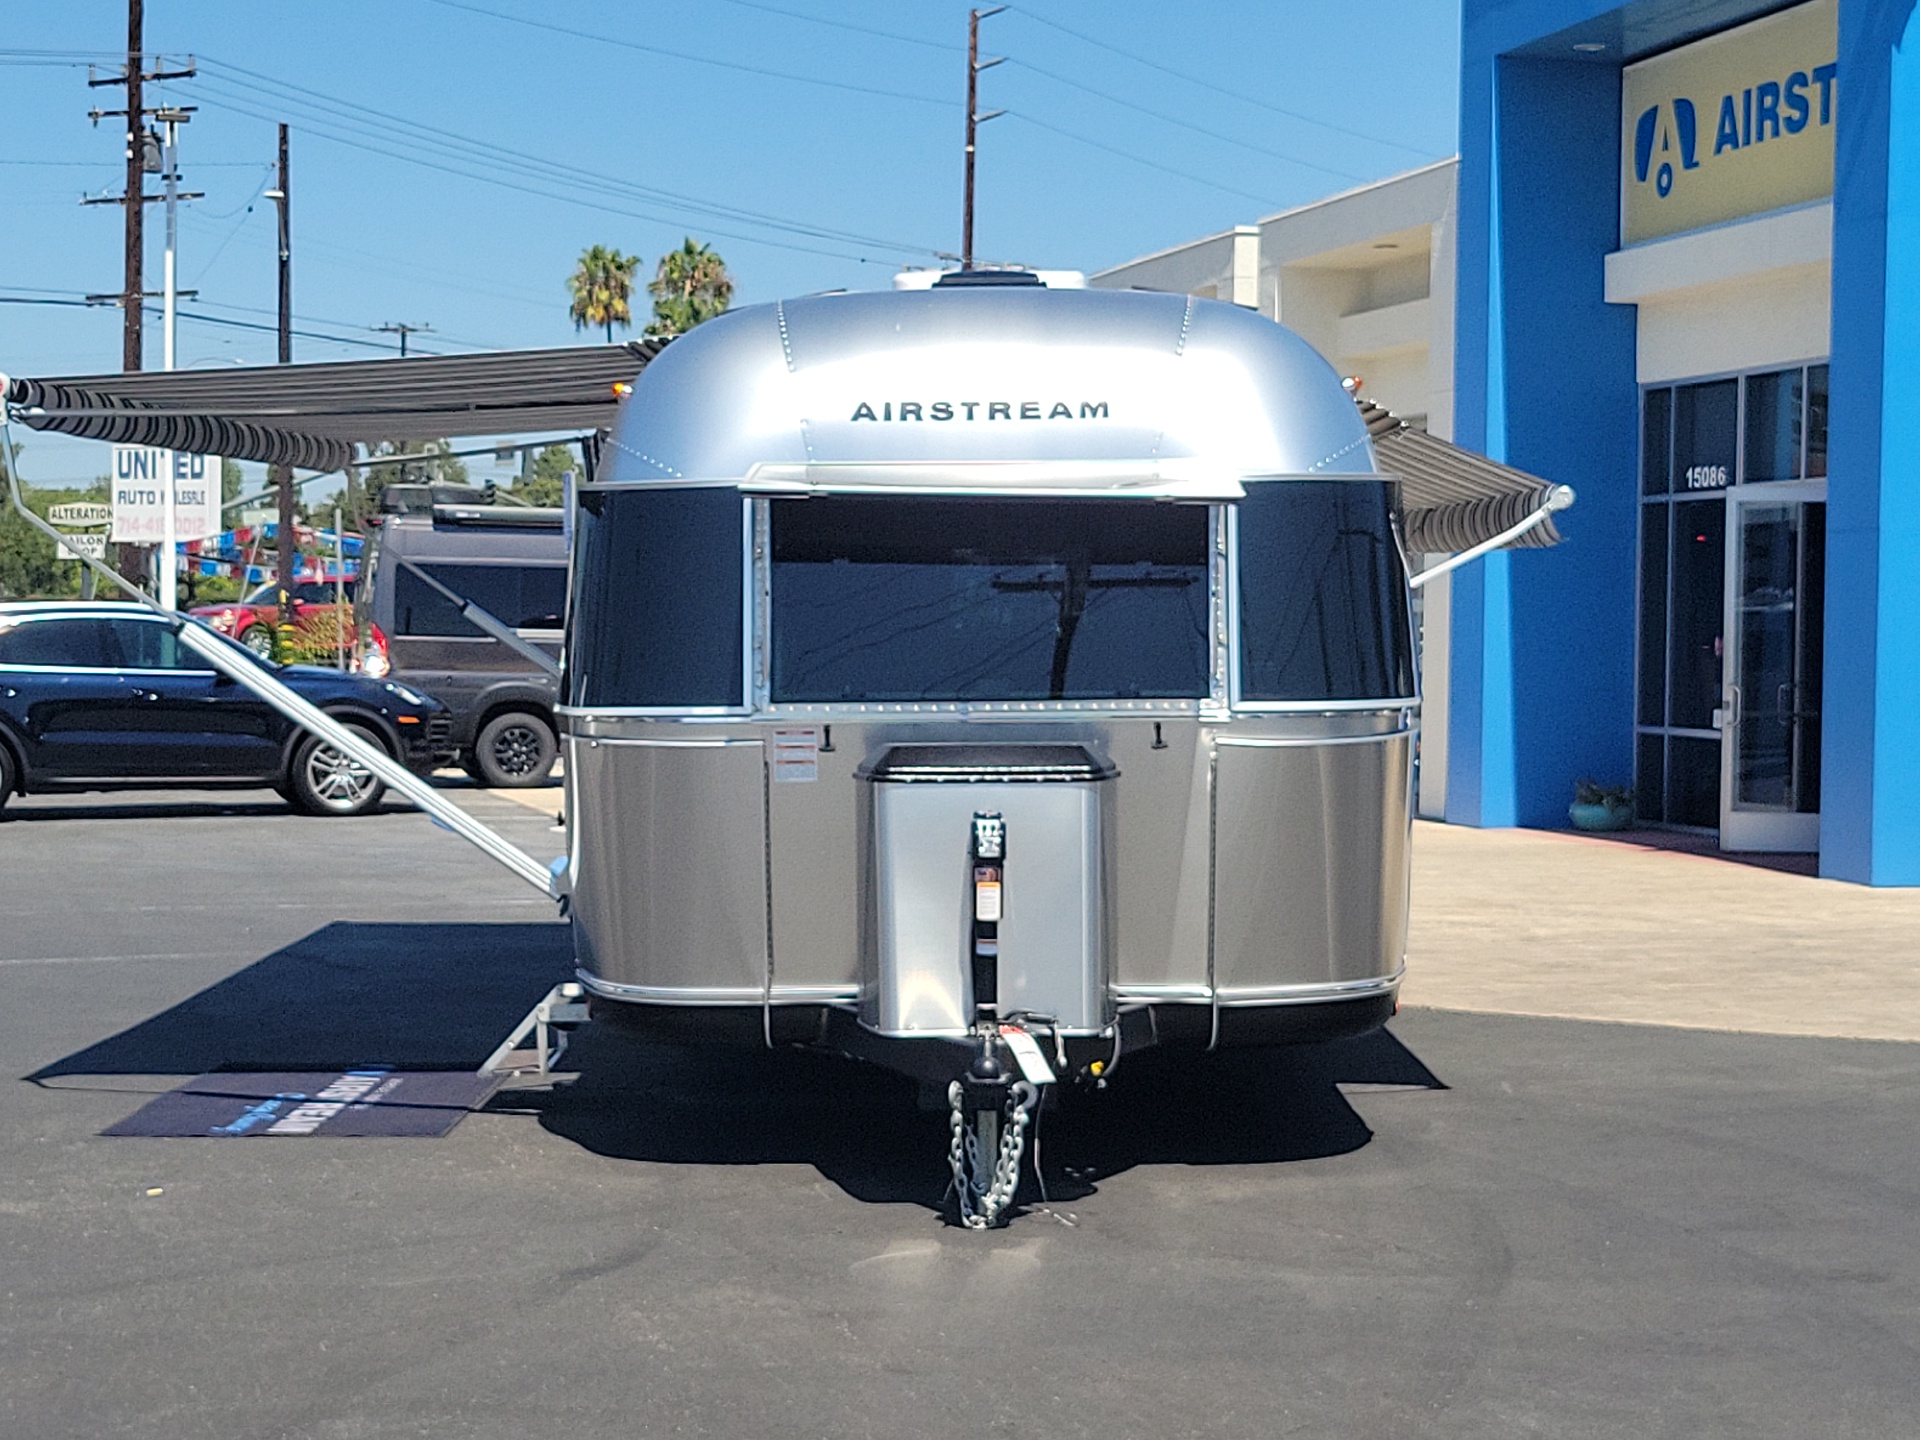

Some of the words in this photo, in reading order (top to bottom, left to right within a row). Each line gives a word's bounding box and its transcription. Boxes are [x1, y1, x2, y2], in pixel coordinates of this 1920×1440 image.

[1714, 63, 1837, 156] AIRST
[850, 401, 1110, 422] AIRSTREAM
[118, 450, 205, 480] UNIED
[1686, 465, 1726, 489] 15086
[118, 490, 156, 506] AUTO
[118, 517, 206, 536] 714-410012
